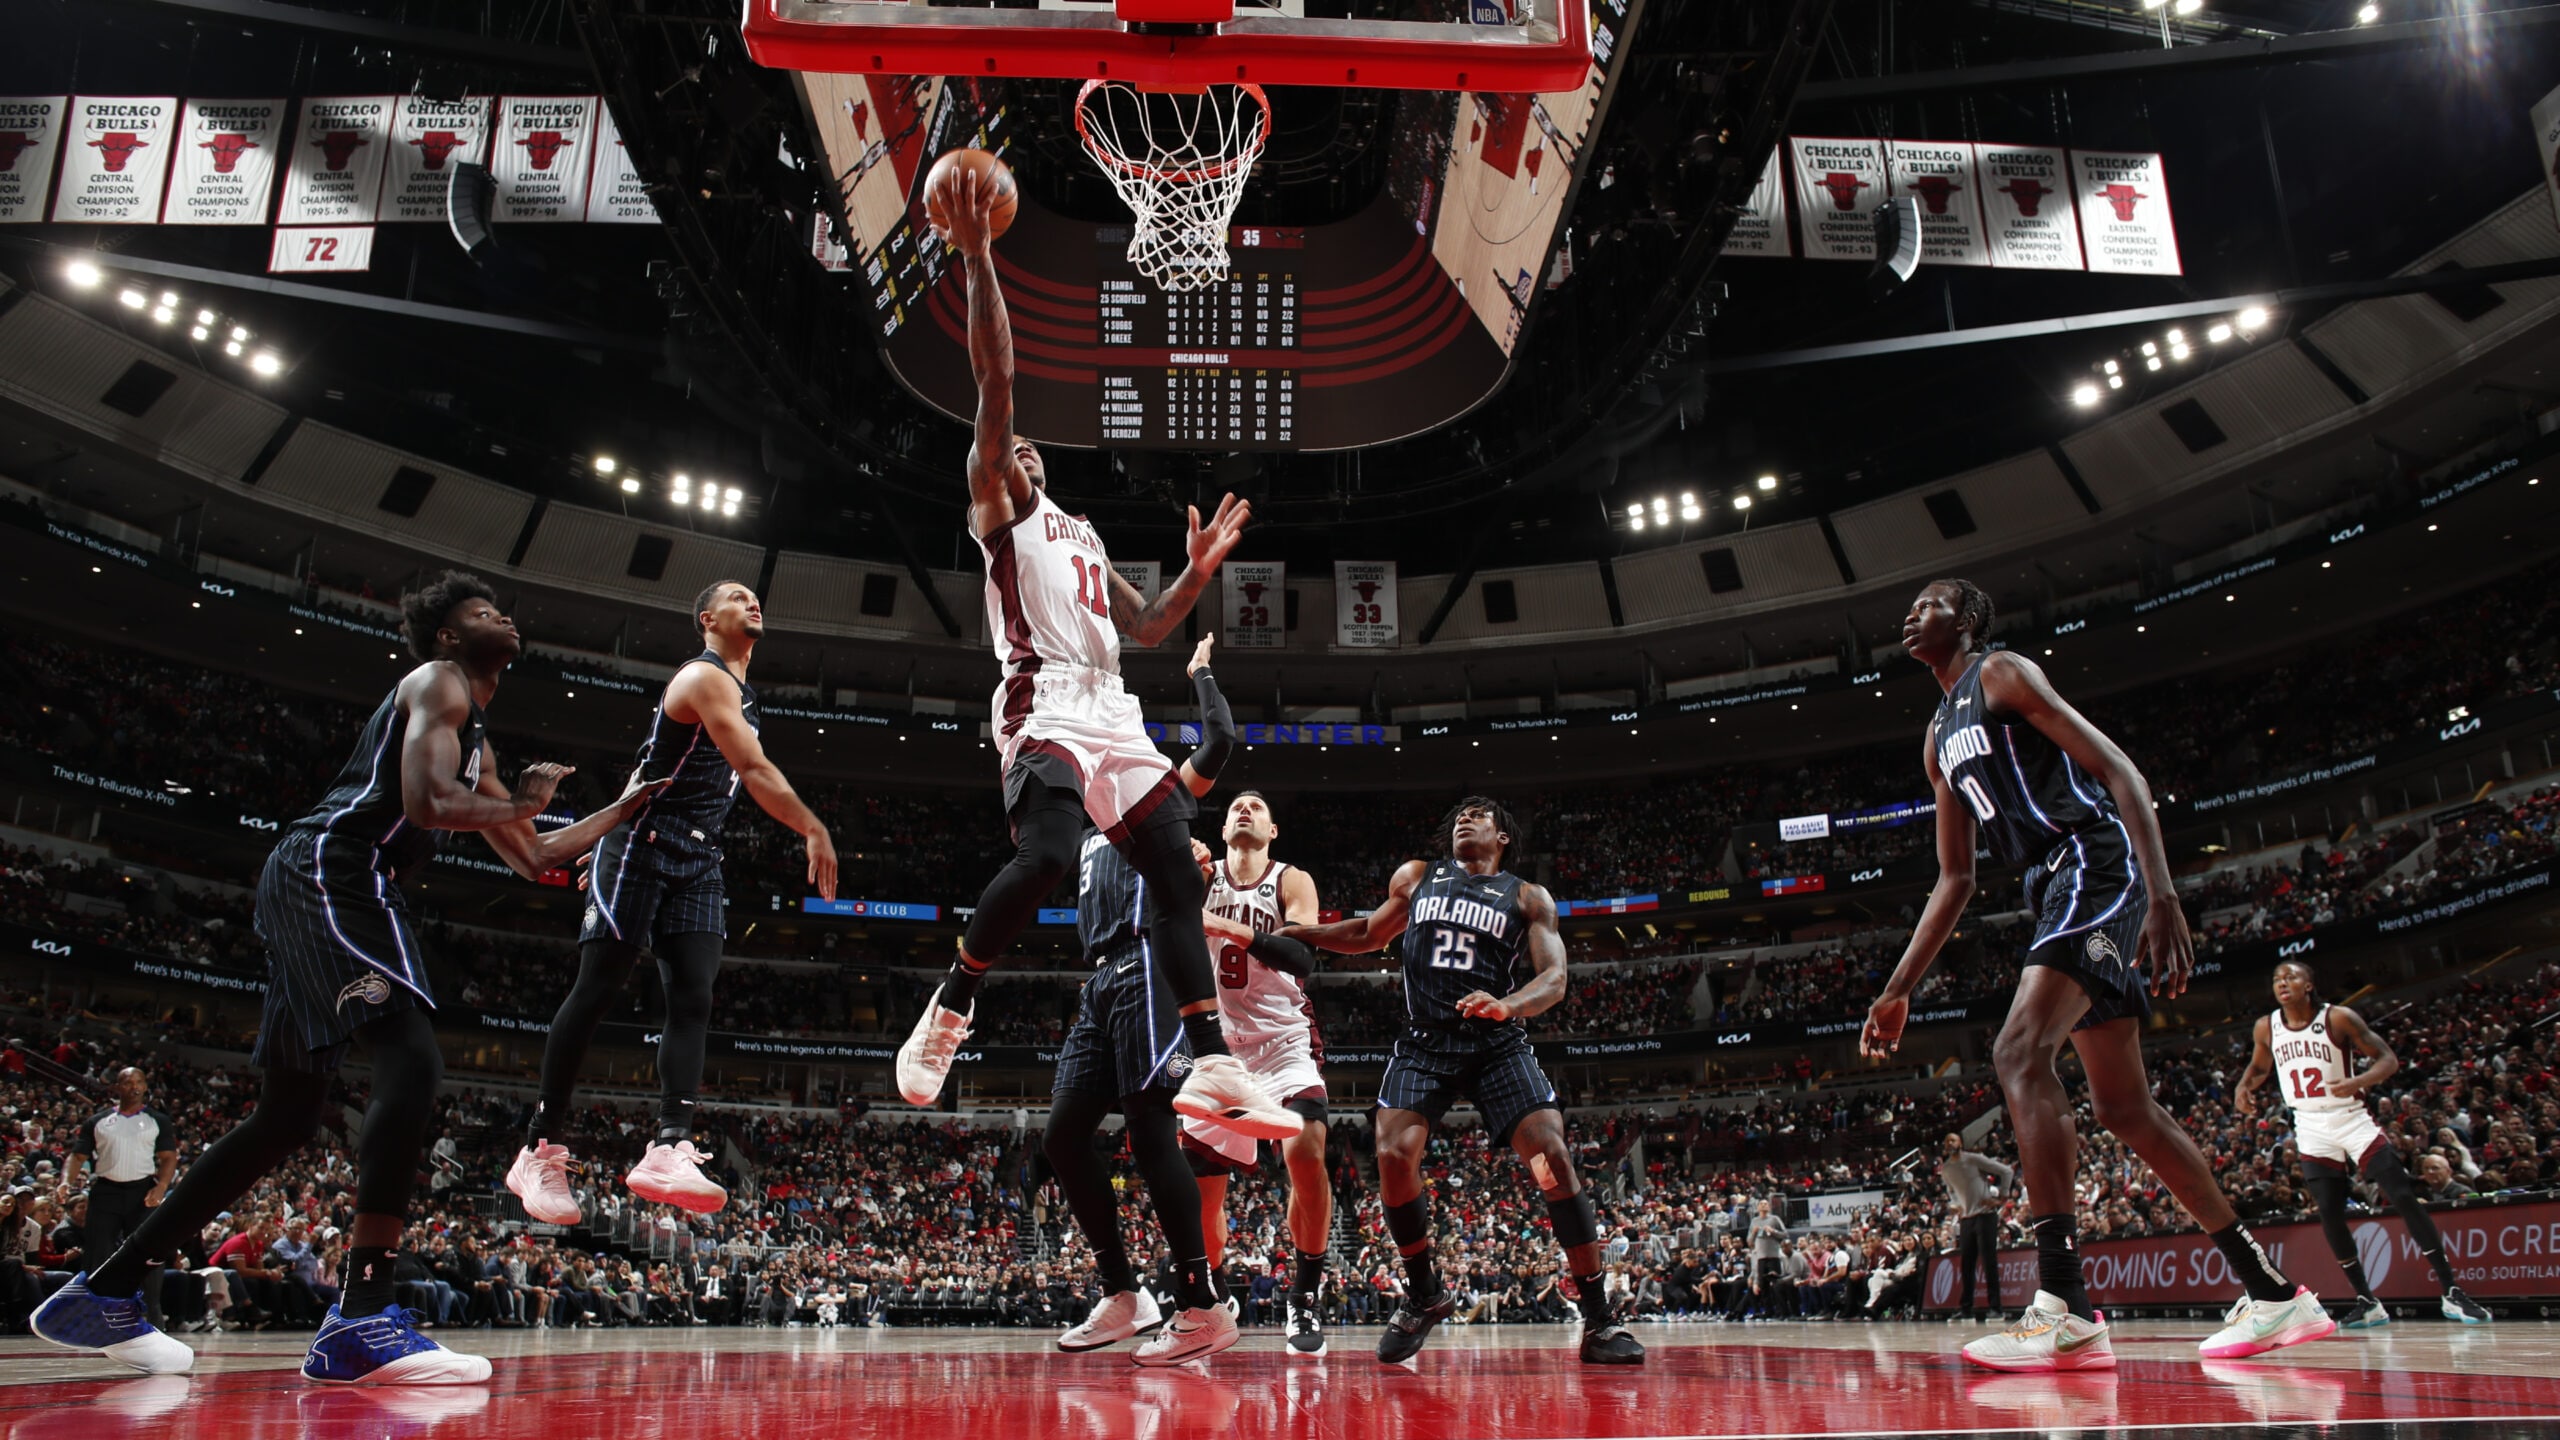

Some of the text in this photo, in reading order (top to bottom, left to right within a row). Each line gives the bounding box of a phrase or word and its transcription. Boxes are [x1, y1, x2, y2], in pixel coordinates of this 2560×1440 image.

[1476, 8, 1499, 23] NBA
[86, 104, 161, 117] CHICAGO
[197, 105, 271, 118] CHICAGO
[311, 104, 381, 116] CHICAGO
[407, 104, 479, 116] CHICAGO
[512, 104, 583, 116] CHICAGO
[96, 118, 149, 130] BULLS
[207, 119, 259, 131] BULLS
[319, 117, 369, 130] BULLS
[416, 117, 467, 129] BULLS
[522, 117, 573, 129] BULLS
[1805, 145, 1872, 158] CHICAGO
[1896, 149, 1962, 162] CHICAGO
[1817, 159, 1864, 170] BULLS
[1987, 152, 2054, 165] CHICAGO
[2084, 157, 2149, 170] CHICAGO
[1910, 163, 1956, 174] BULLS
[2000, 165, 2046, 177] BULLS
[90, 174, 134, 183] CENTRAL
[200, 175, 243, 184] CENTRAL
[313, 171, 354, 181] CENTRAL
[517, 173, 560, 182] CENTRAL
[2096, 170, 2142, 182] BULLS
[86, 184, 134, 194] DIVISION
[196, 185, 243, 195] DIVISION
[309, 183, 354, 193] DIVISION
[514, 184, 560, 193] DIVISION
[77, 196, 140, 206] CHAMPIONS
[187, 196, 249, 207] CHAMPIONS
[300, 194, 359, 205] CHAMPIONS
[505, 195, 567, 205] CHAMPIONS
[1828, 212, 1867, 221] EASTERN
[2011, 219, 2050, 228] EASTERN
[2109, 224, 2147, 234] EASTERN
[1242, 229, 1260, 246] 35
[2004, 230, 2061, 241] CONFERENCE
[2102, 235, 2158, 246] CONFERENCE
[305, 237, 338, 262] 72
[2006, 241, 2062, 252] CHAMPIONS
[2103, 246, 2158, 257] CHAMPIONS
[1111, 281, 1134, 291] BAMBA
[1100, 294, 1147, 304] 25 SCHOFIELD
[1111, 320, 1133, 331] SUGGS
[1170, 353, 1229, 364] CHICAGO BULLS
[1111, 377, 1132, 387] WHITE
[1111, 390, 1139, 400] VUCEVIC
[1100, 403, 1241, 414] 44 WILLIAMS 2/3
[1102, 416, 1109, 426] 12
[1168, 417, 1176, 427] 12
[1103, 429, 1291, 441] 11 DEROZAN 13 2/2
[2420, 496, 2438, 508] The
[2438, 489, 2453, 500] Kia
[2453, 472, 2491, 492] Telluride
[47, 523, 148, 567] The Kia Telluride X-Pro
[1071, 554, 1108, 619] 11
[1239, 606, 1269, 627] 23
[1353, 604, 1382, 624] 33
[857, 715, 889, 726] driveway
[1244, 723, 1385, 746] ENTER
[52, 765, 175, 806] The Kia Telluride X-Pro
[2194, 754, 2376, 812] Here's to the legends of the driveway
[1897, 808, 1913, 817] FOR
[1835, 818, 1855, 828] TEXT
[473, 857, 515, 877] driveway
[1689, 888, 1730, 903] REBOUNDS
[2378, 872, 2550, 932] Here's legends of the driveway
[874, 904, 907, 917] CLUB
[1415, 896, 1507, 939] ORLANDO
[1431, 928, 1476, 970] 25
[1220, 944, 1249, 989] 9
[134, 960, 257, 992] Here's to the legends of
[481, 1015, 515, 1028] The Kia
[1807, 1008, 1967, 1036] Here's driveway
[735, 1040, 894, 1060] Here's legends driveway
[1566, 1040, 1661, 1055] The Kia Telluride X-Pro
[2275, 1040, 2332, 1067] CHICAGO
[2290, 1067, 2326, 1099] 12
[2401, 1228, 2487, 1261] WND
[2081, 1249, 2177, 1289] COMING
[2427, 1261, 2560, 1282] CCAGO SOUTHLAN
